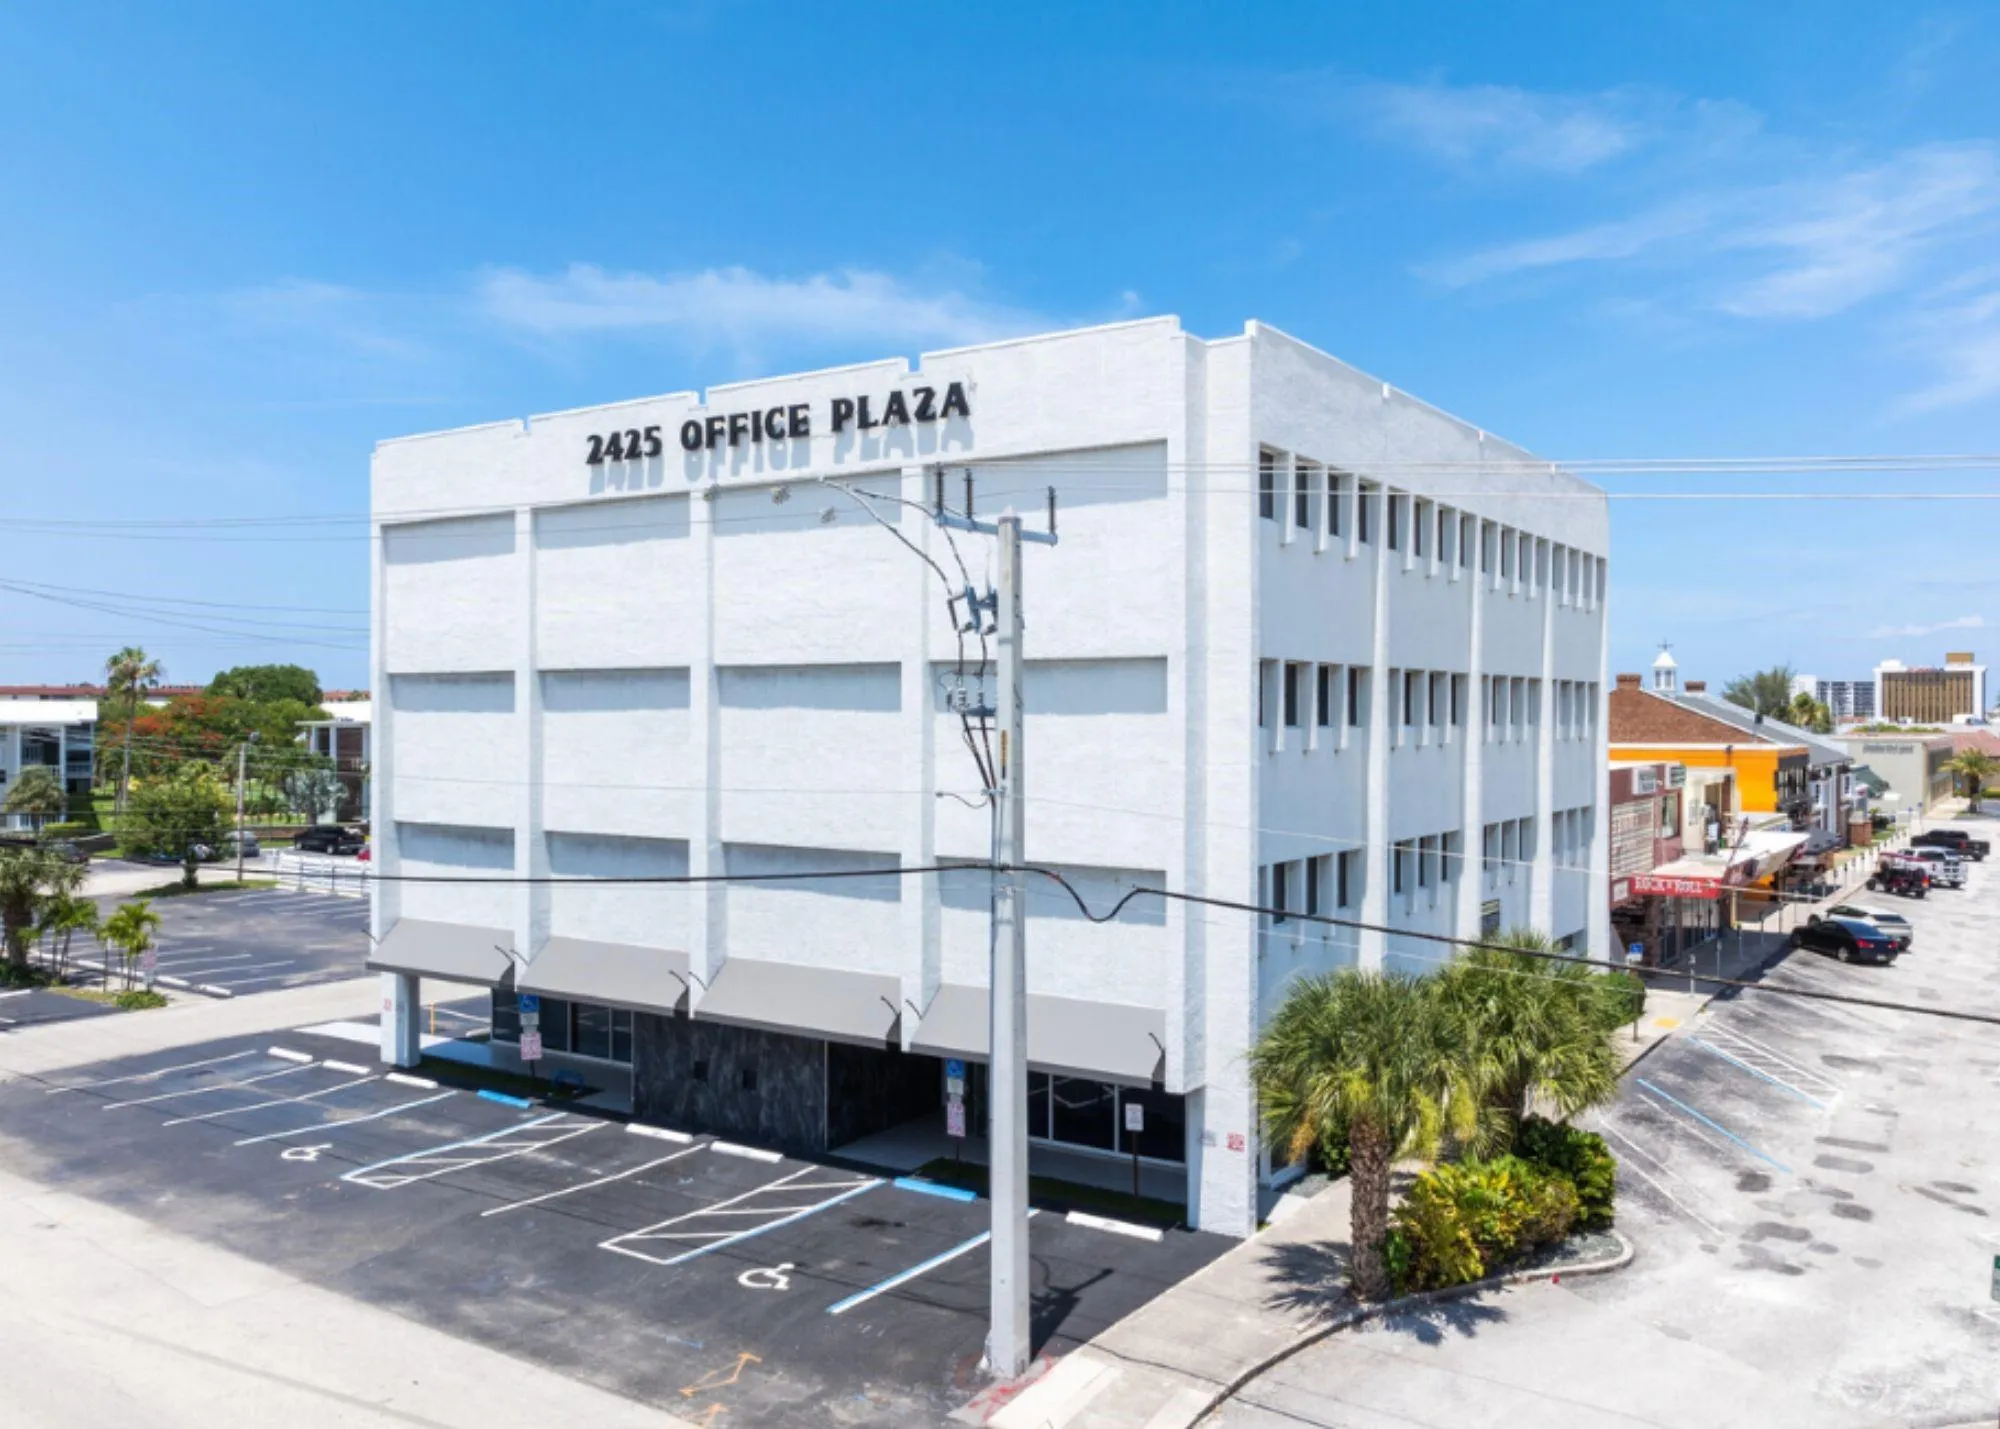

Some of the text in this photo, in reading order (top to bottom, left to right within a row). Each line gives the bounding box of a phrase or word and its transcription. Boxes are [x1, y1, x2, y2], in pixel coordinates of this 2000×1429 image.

[586, 382, 970, 465] 2425 OFFICE PLAZA
